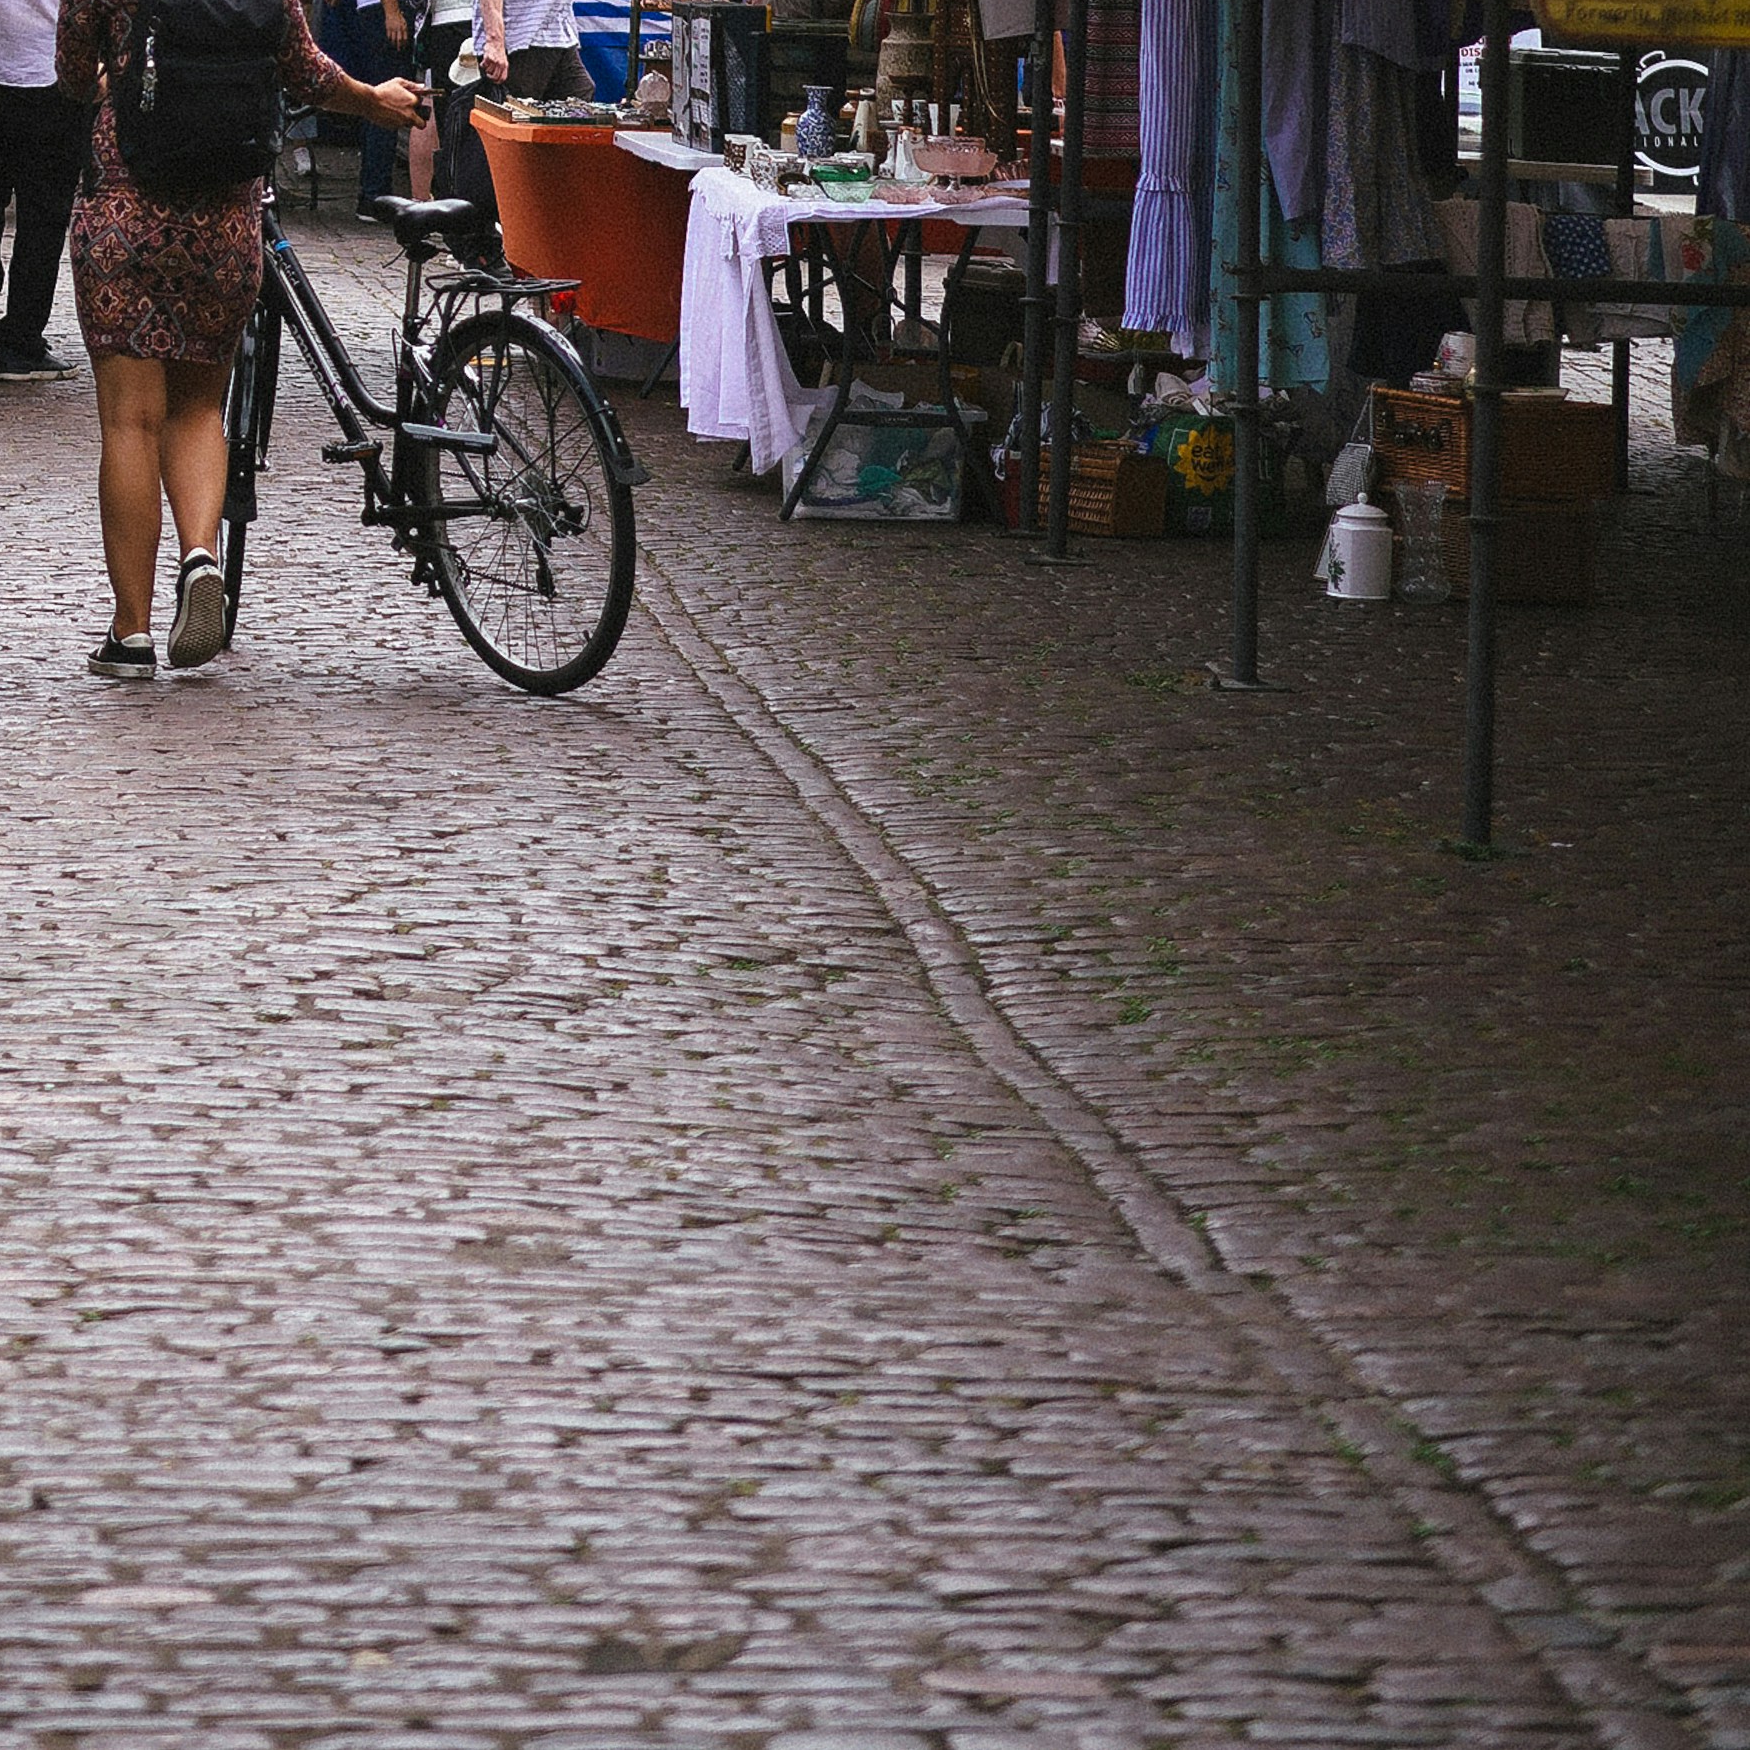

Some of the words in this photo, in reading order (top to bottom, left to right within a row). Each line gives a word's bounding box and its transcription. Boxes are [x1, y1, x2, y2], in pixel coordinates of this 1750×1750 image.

[1635, 87, 1707, 135] ACK
[1642, 135, 1699, 148] IONAL
[290, 323, 337, 408] ammaco
[1191, 444, 1220, 459] eat
